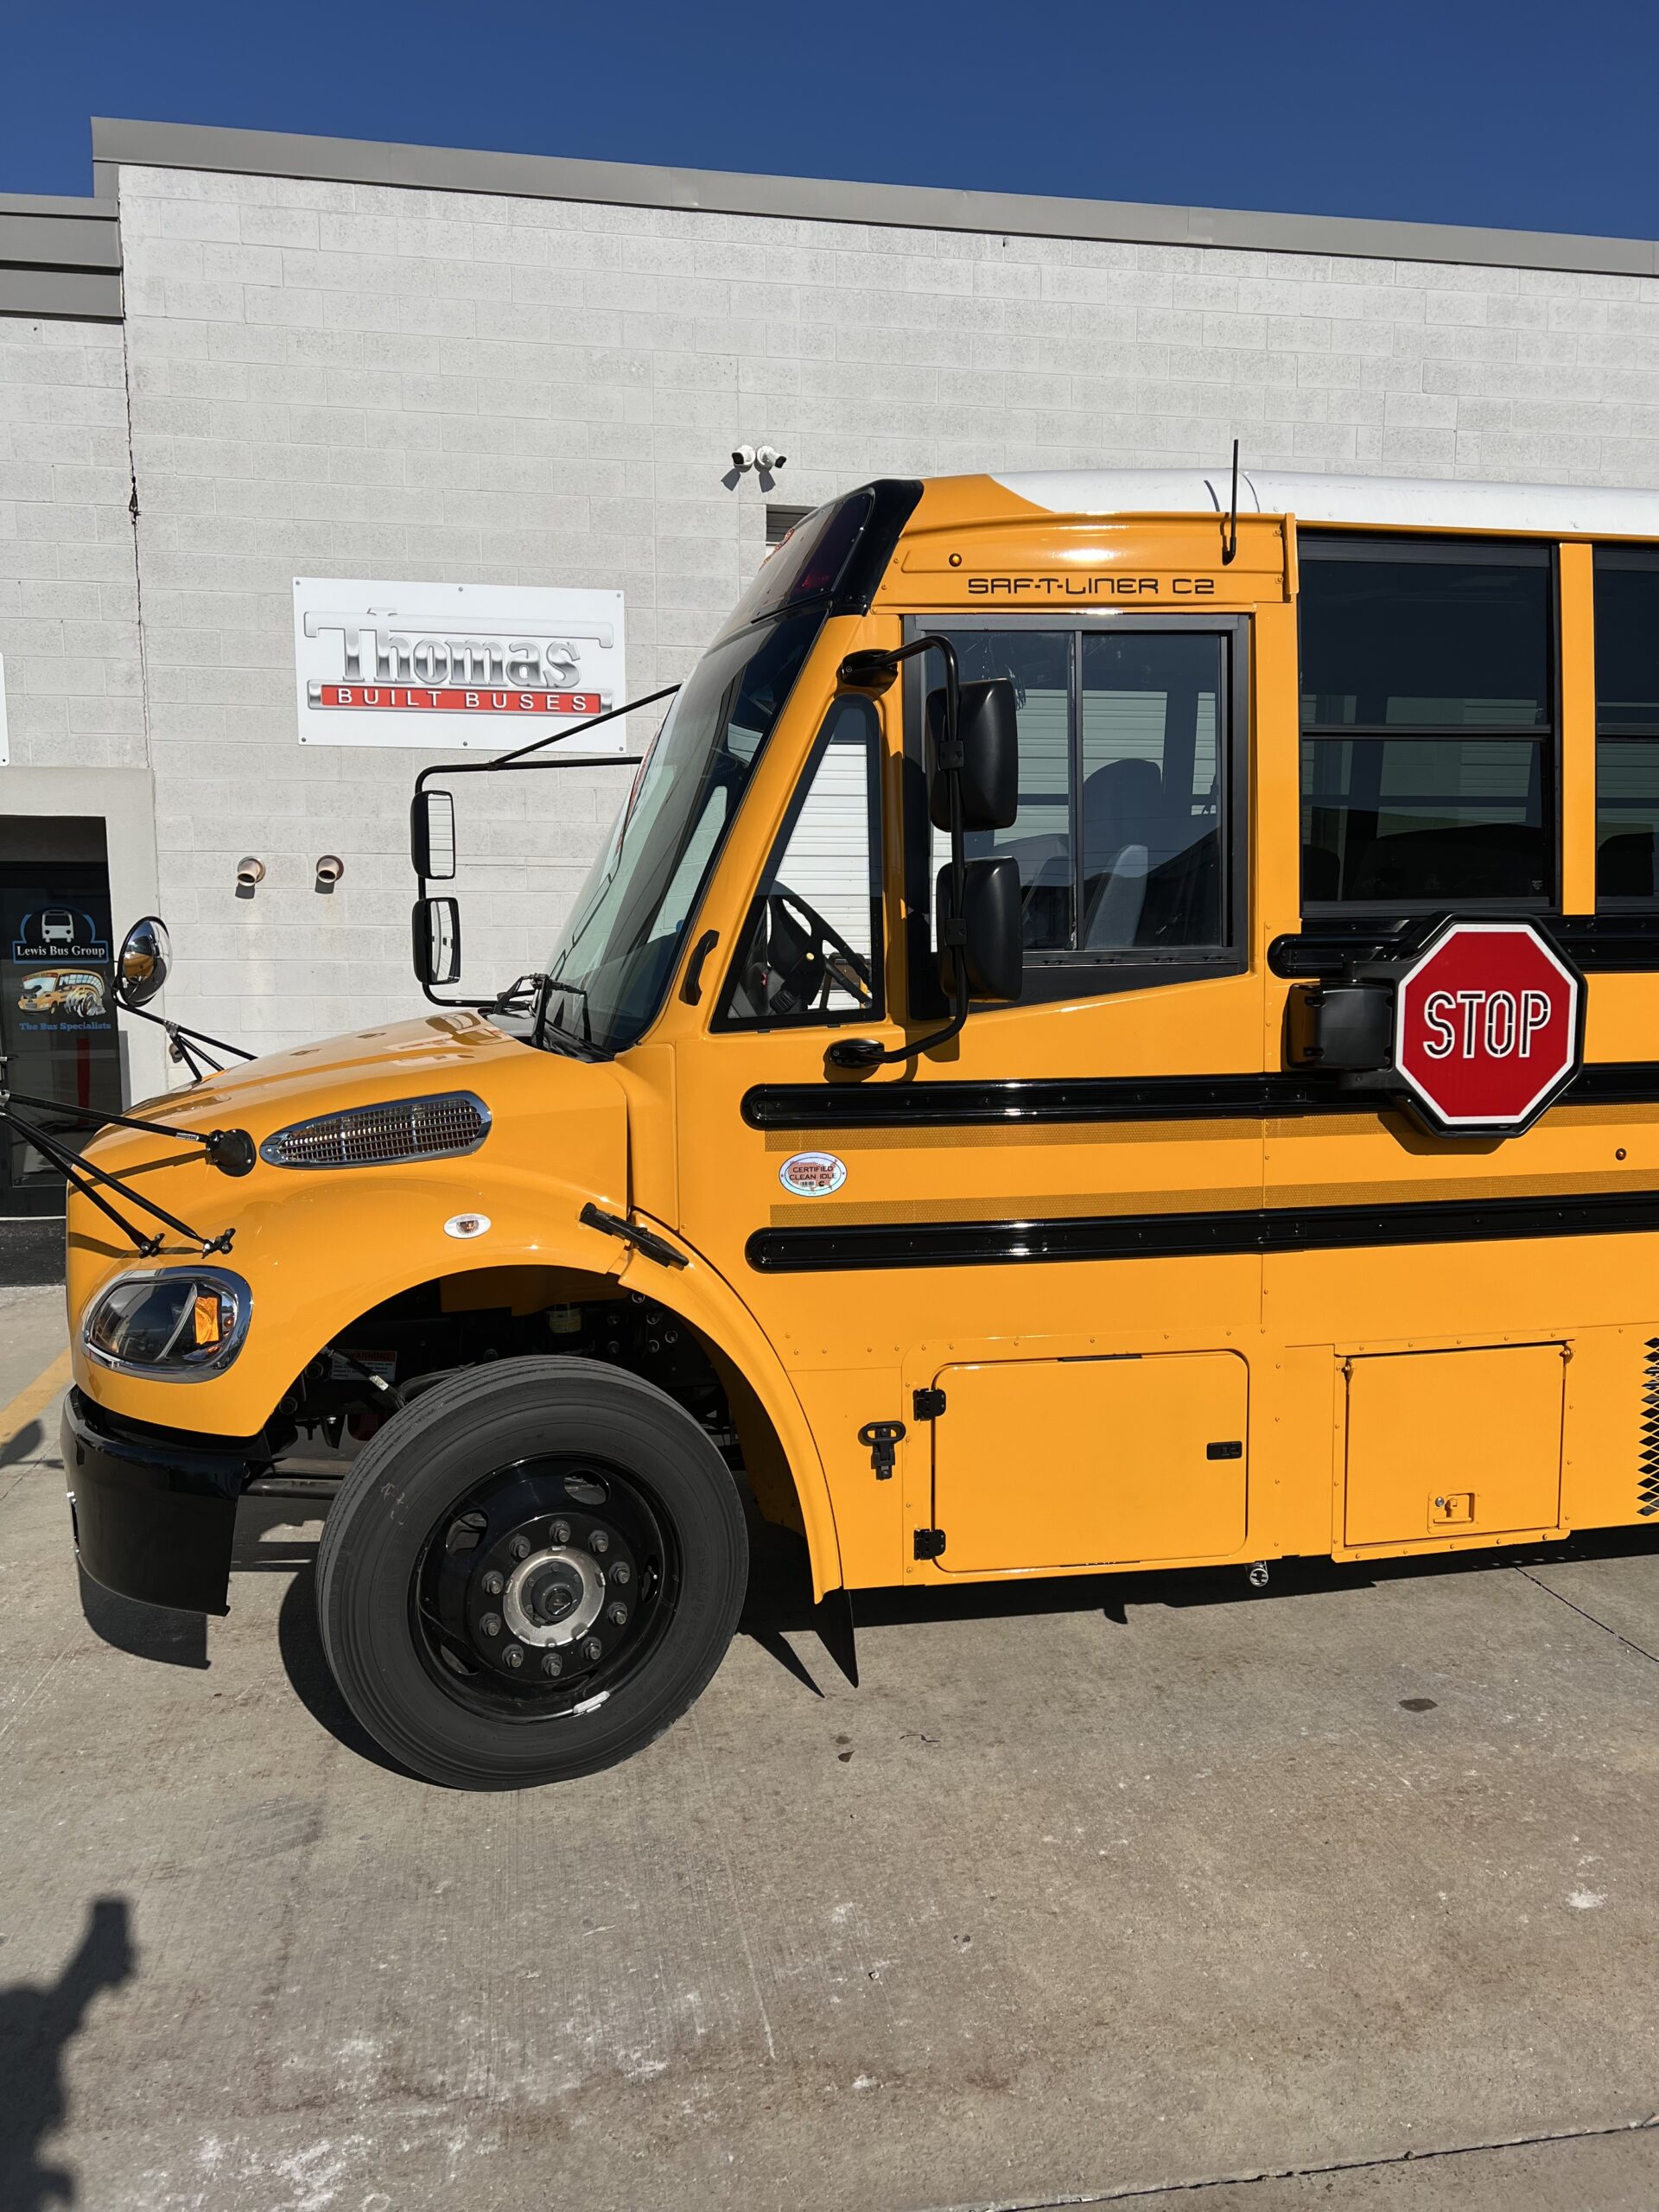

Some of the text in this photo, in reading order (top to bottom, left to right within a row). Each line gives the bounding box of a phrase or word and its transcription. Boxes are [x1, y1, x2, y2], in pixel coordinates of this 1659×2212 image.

[968, 577, 1215, 595] SAF-T-LINER C2
[304, 607, 613, 689] Thomas
[337, 687, 588, 711] BUILT BUSES
[16, 945, 105, 957] Lewis Bus Group
[19, 1022, 111, 1032] The Bus Specialists
[1422, 990, 1552, 1059] STOP
